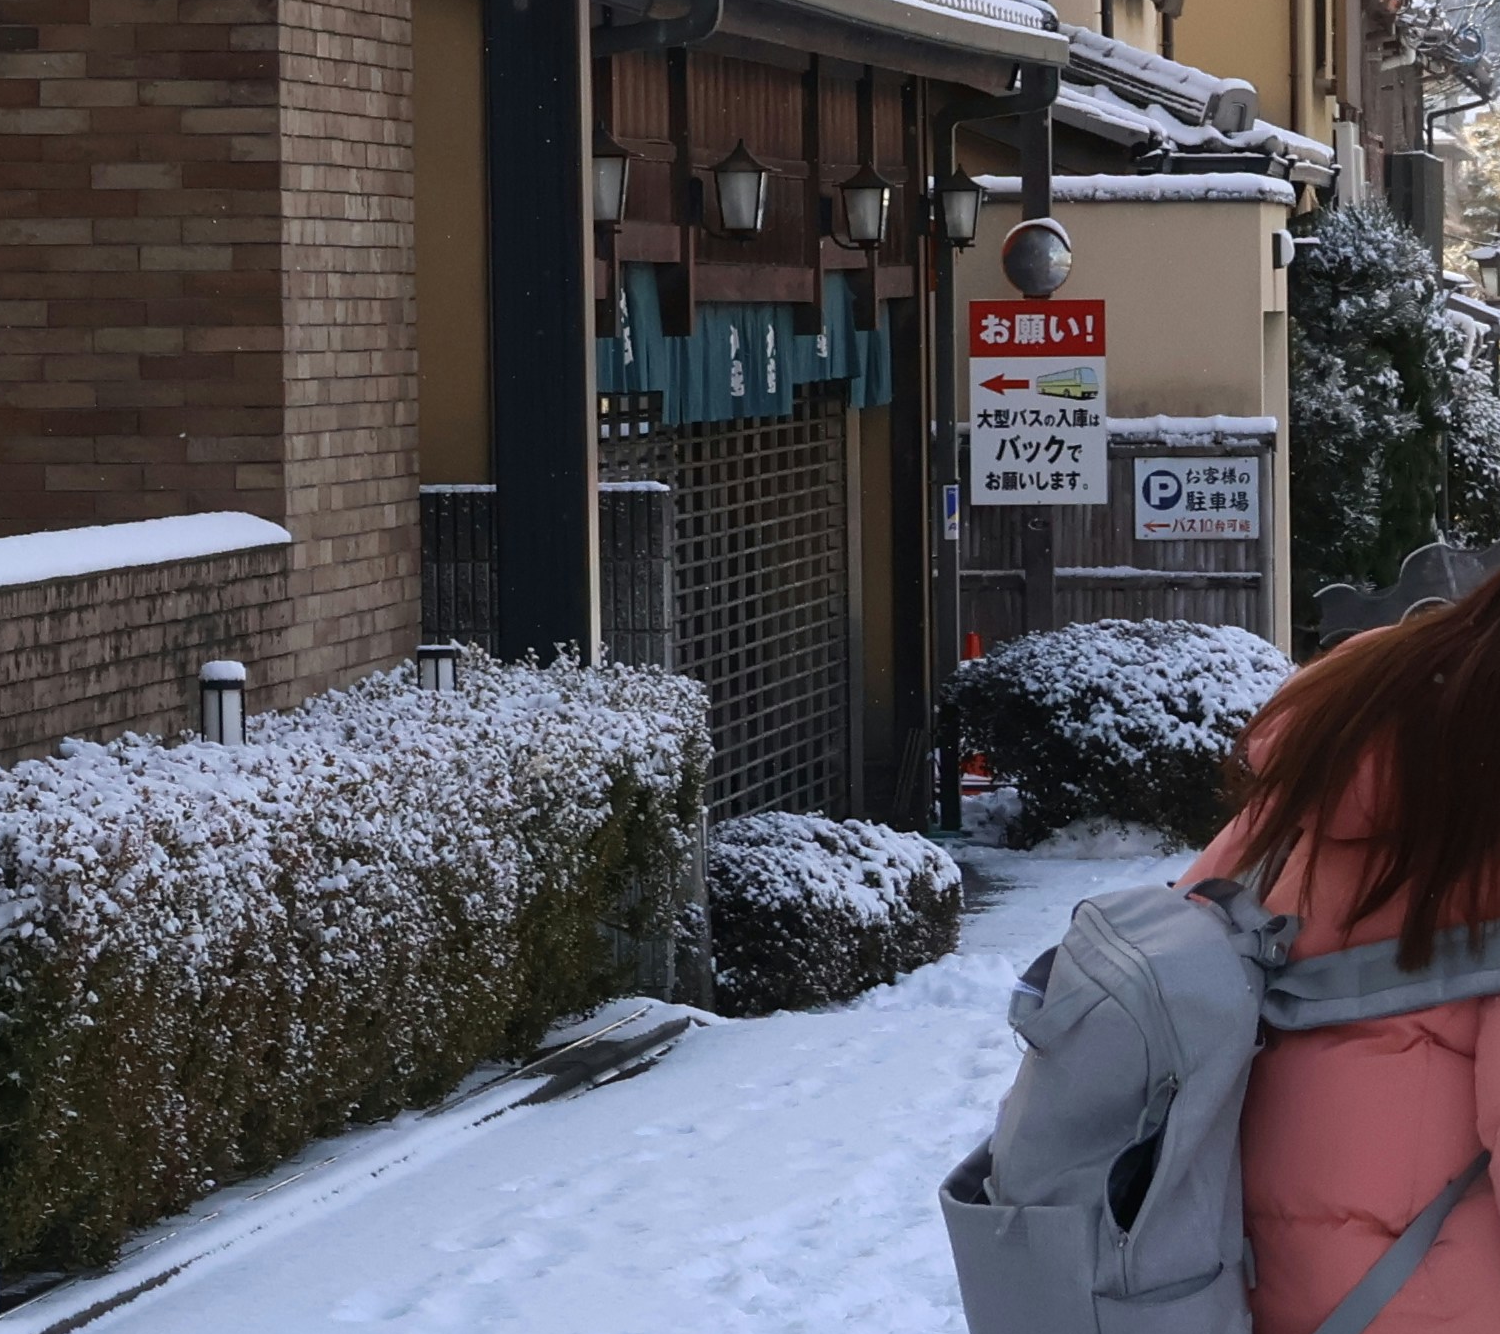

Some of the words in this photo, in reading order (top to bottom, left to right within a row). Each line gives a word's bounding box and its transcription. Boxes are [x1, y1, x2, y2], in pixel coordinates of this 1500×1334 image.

[979, 313, 1094, 345] お願い!
[977, 408, 1100, 429] 大型バスの入庫は
[995, 434, 1083, 464] バックで
[985, 471, 1088, 491] お願いします。
[1185, 466, 1250, 485] お客様の
[1149, 475, 1179, 506] P
[1185, 490, 1250, 512] 駐車場
[1171, 517, 1251, 533] バス10台可能
